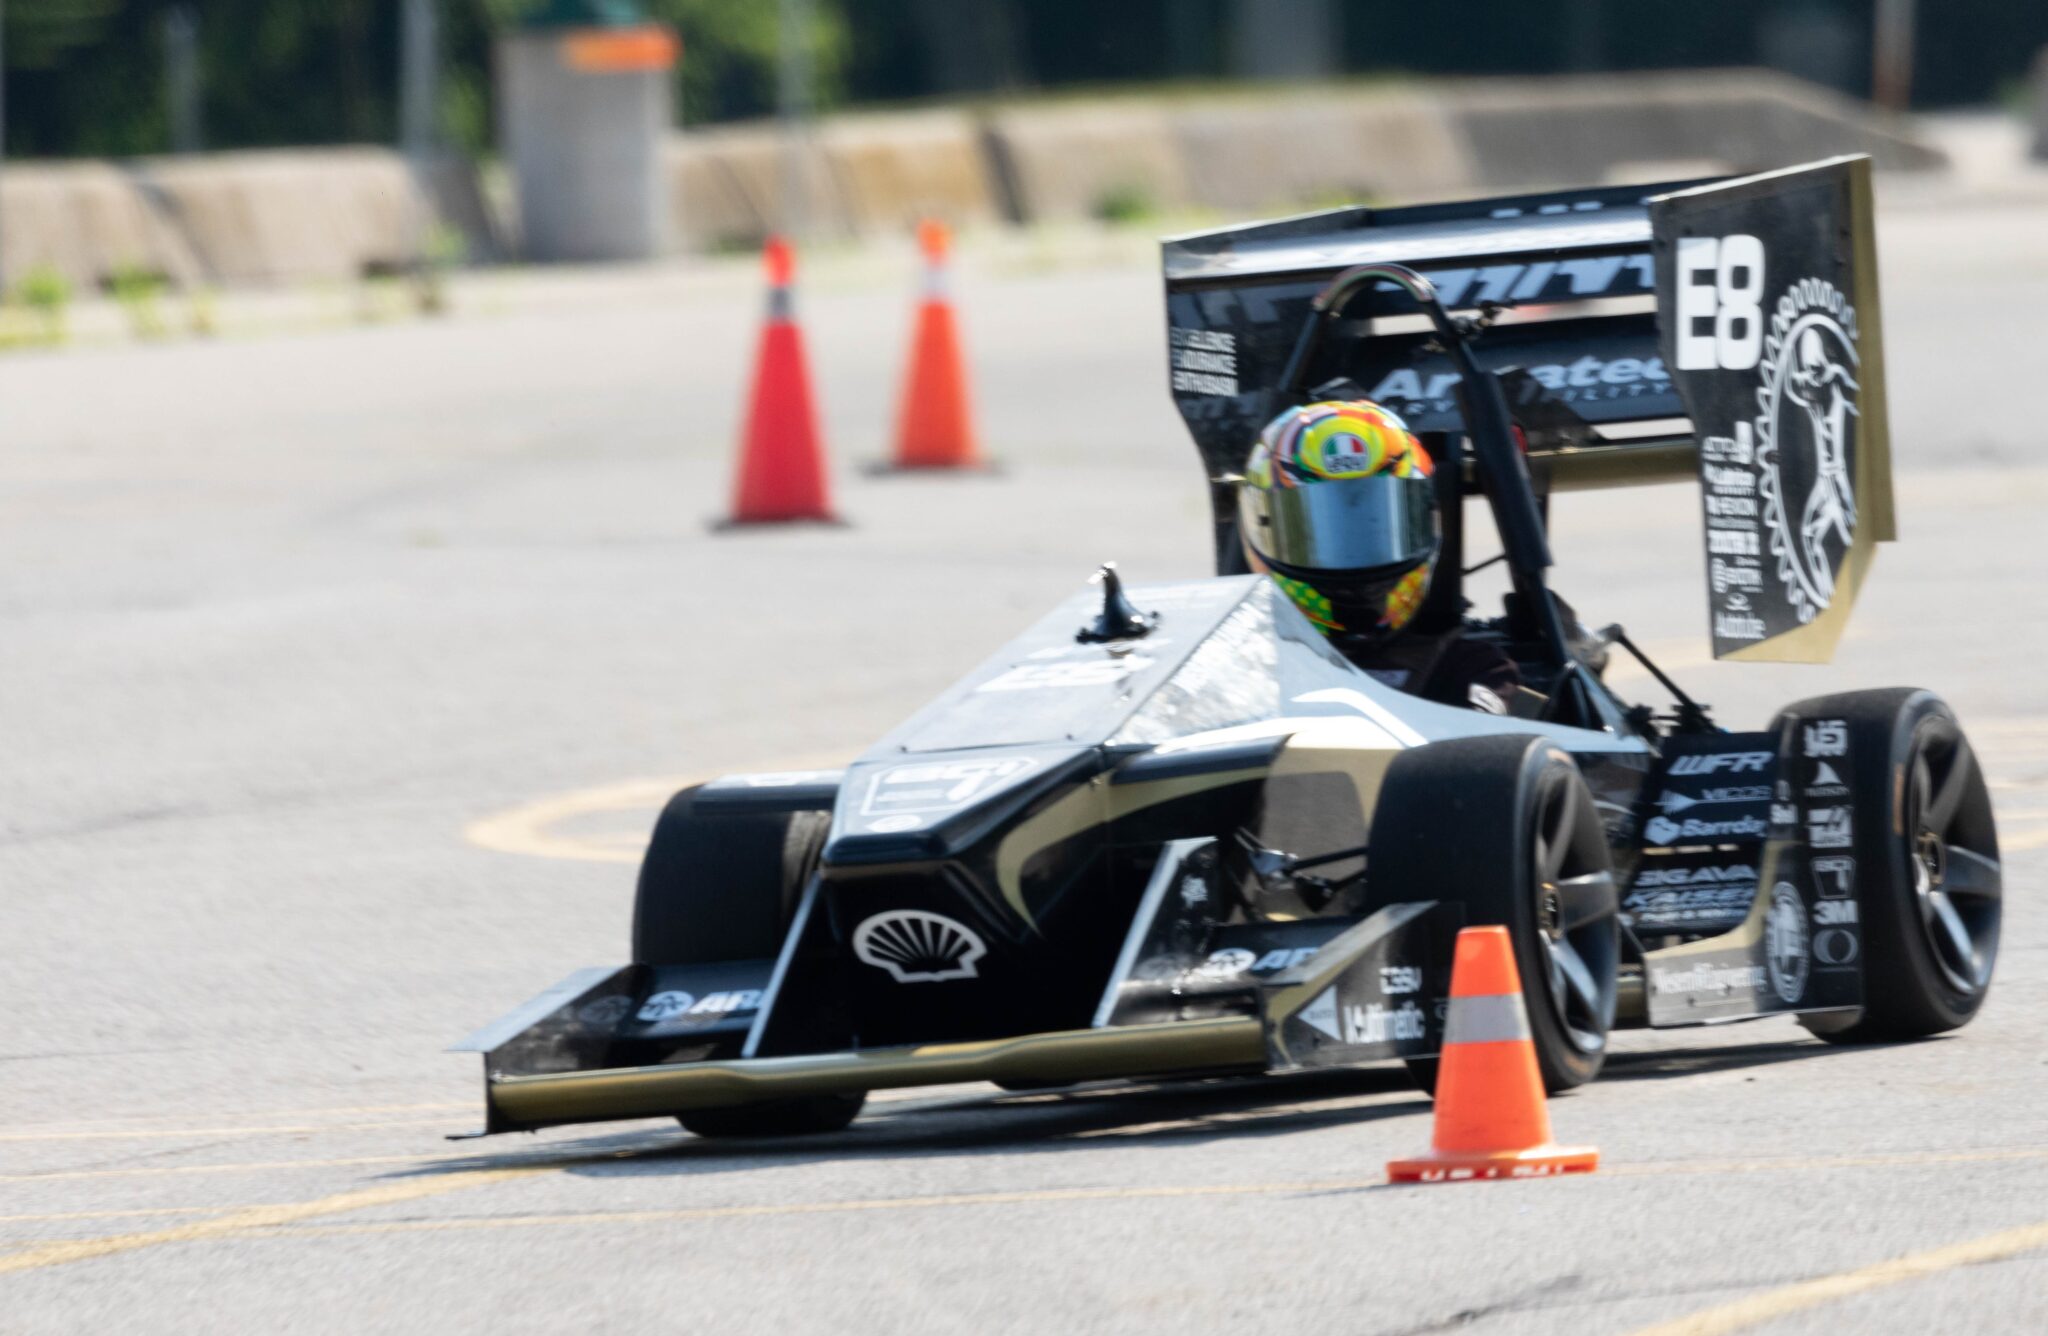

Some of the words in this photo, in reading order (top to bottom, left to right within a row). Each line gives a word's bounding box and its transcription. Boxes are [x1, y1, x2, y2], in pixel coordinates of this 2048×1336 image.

[1676, 234, 1766, 371] E8
[1667, 751, 1775, 776] WFR
[1814, 900, 1858, 925] 3M
